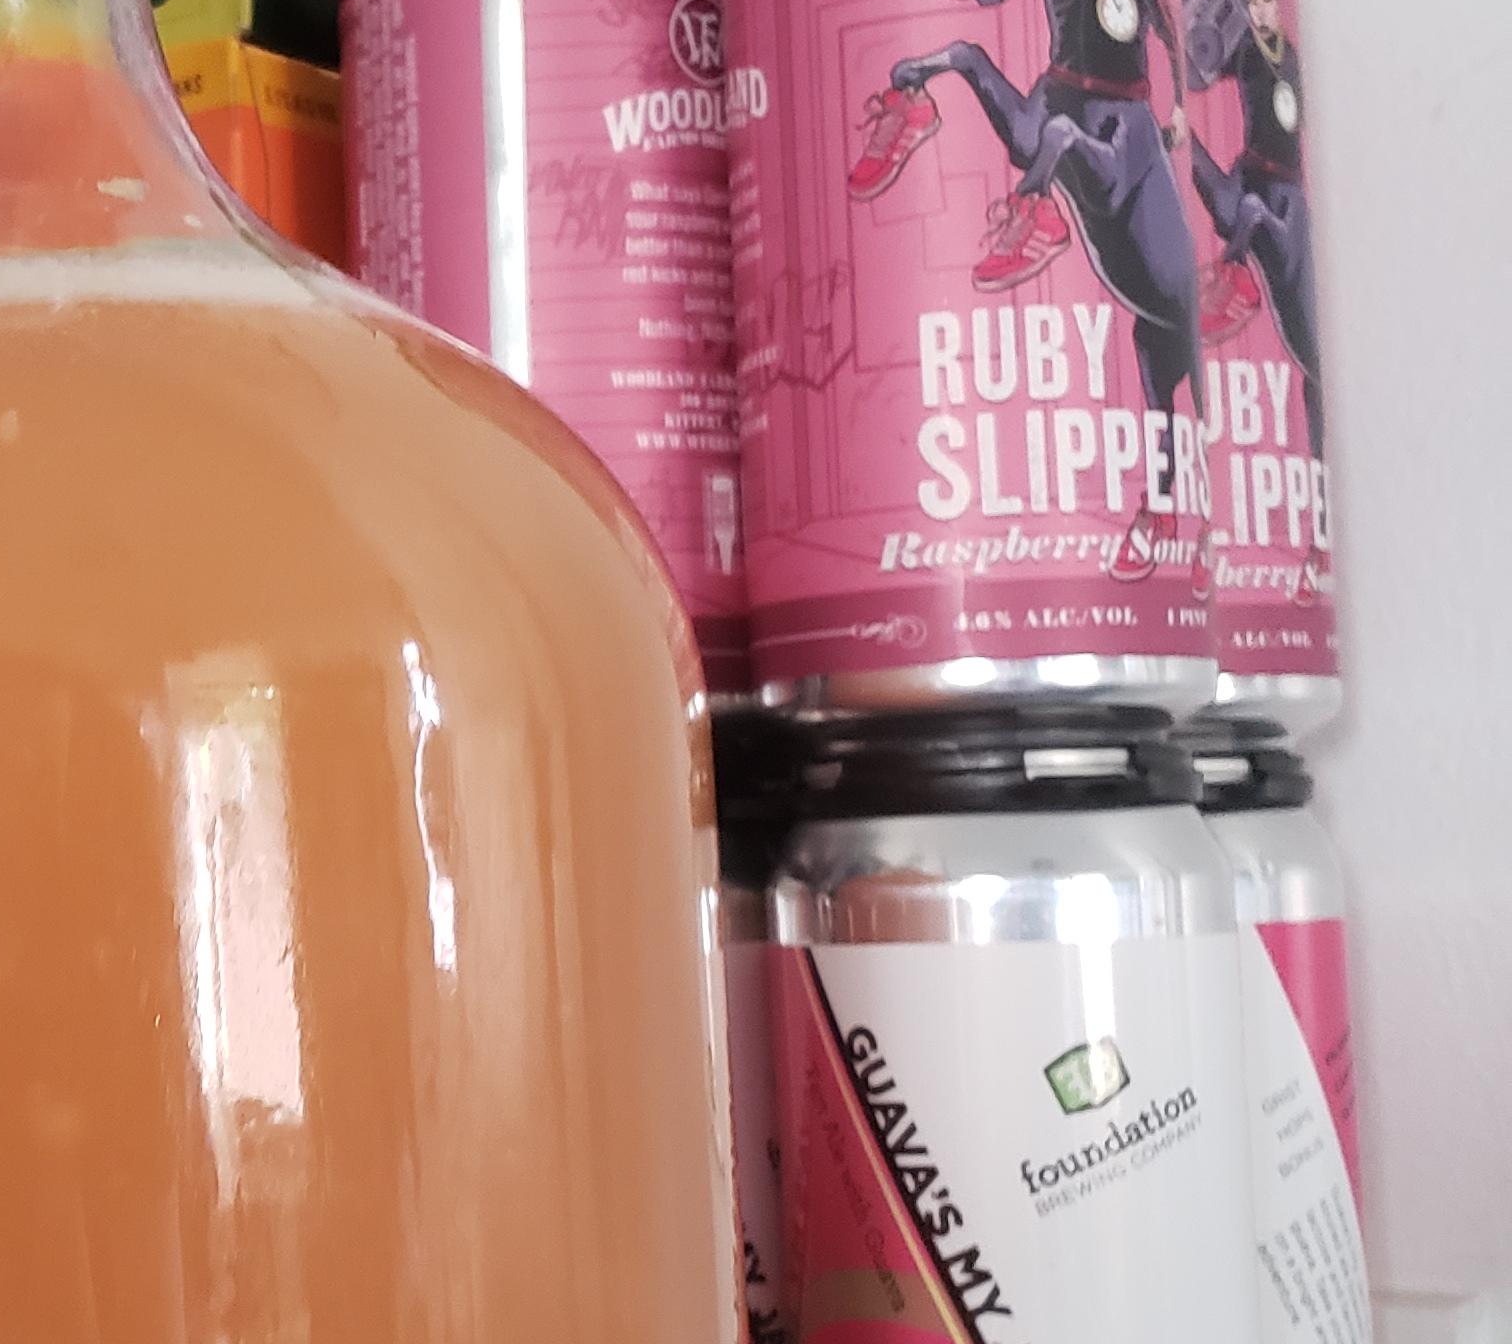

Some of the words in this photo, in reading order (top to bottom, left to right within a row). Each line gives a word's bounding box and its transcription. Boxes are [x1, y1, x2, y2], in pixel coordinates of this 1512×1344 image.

[917, 302, 1114, 409] RUBY
[916, 407, 1215, 522] SLIPPERS
[878, 524, 1125, 576] Raspberry
[844, 1026, 965, 1239] GUAVA'S
[944, 1247, 1012, 1342] MY
[1020, 1085, 1198, 1195] foundation
